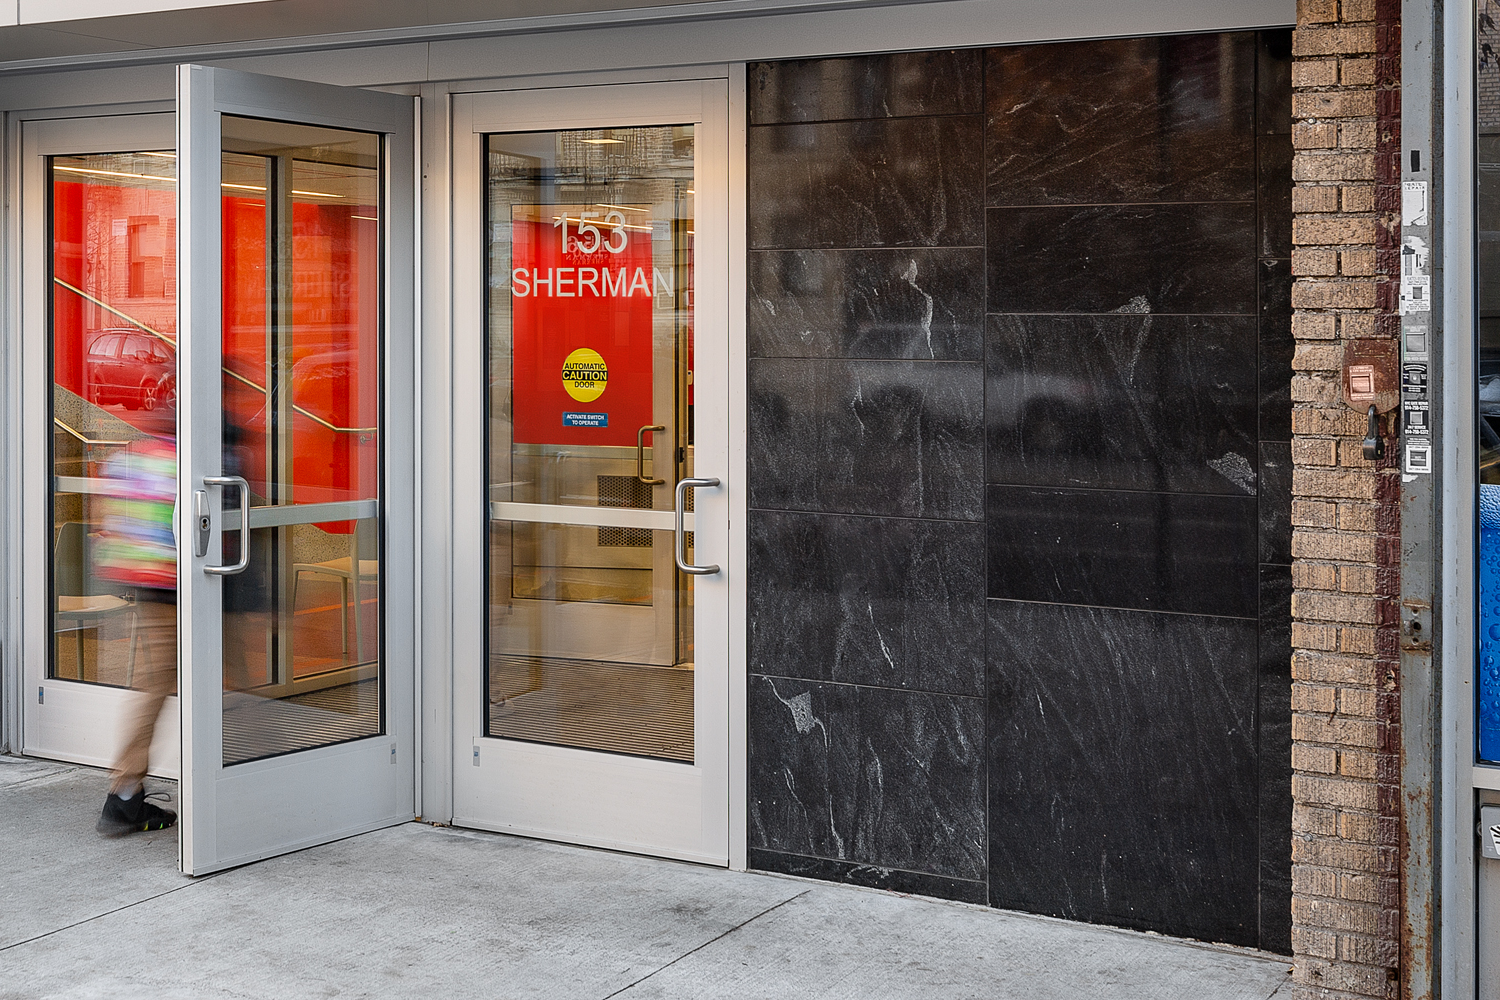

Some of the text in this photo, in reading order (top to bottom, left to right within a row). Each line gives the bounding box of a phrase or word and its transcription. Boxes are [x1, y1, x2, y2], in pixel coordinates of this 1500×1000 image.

[553, 211, 628, 254] 153
[511, 267, 674, 298] SHERMAN
[563, 371, 607, 380] CAUTION
